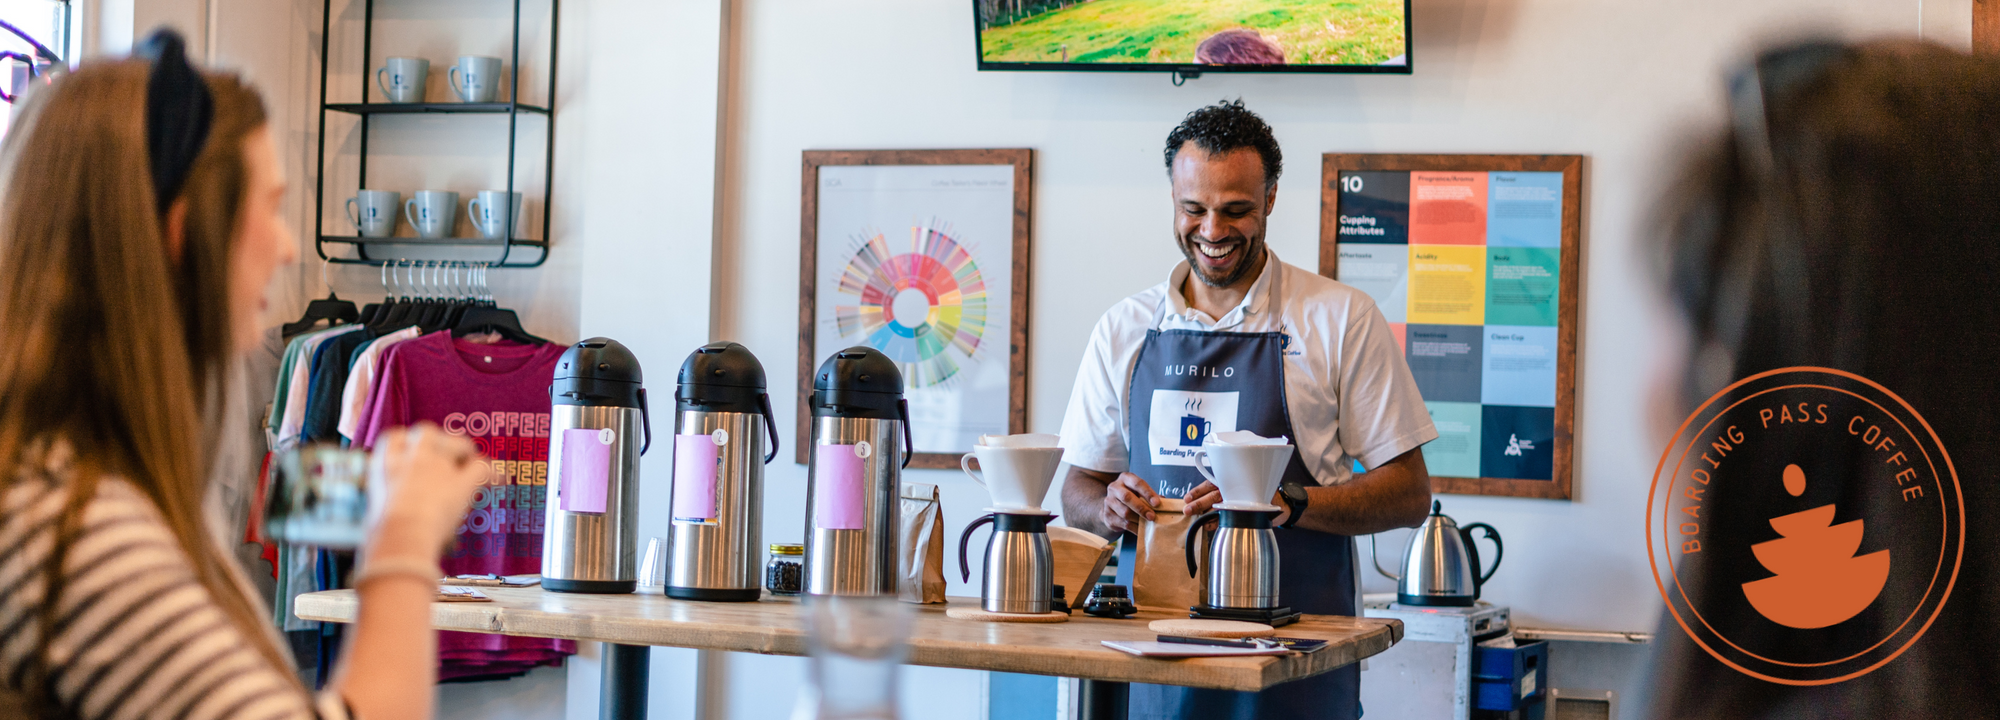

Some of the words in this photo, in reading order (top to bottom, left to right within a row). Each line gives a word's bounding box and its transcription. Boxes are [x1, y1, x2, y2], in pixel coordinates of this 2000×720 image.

[1341, 176, 1363, 193] 10
[1339, 215, 1376, 226] Cupping
[1339, 226, 1385, 236] Attributes
[1164, 365, 1235, 378] MURILO
[443, 411, 550, 438] COFFEE
[604, 430, 610, 442] 1
[717, 431, 723, 443] 2
[470, 436, 549, 461] OFFEE
[860, 443, 866, 456] 3
[1159, 447, 1186, 458] Boarding
[473, 460, 548, 486] OFFEE
[469, 485, 546, 510] OFFEE
